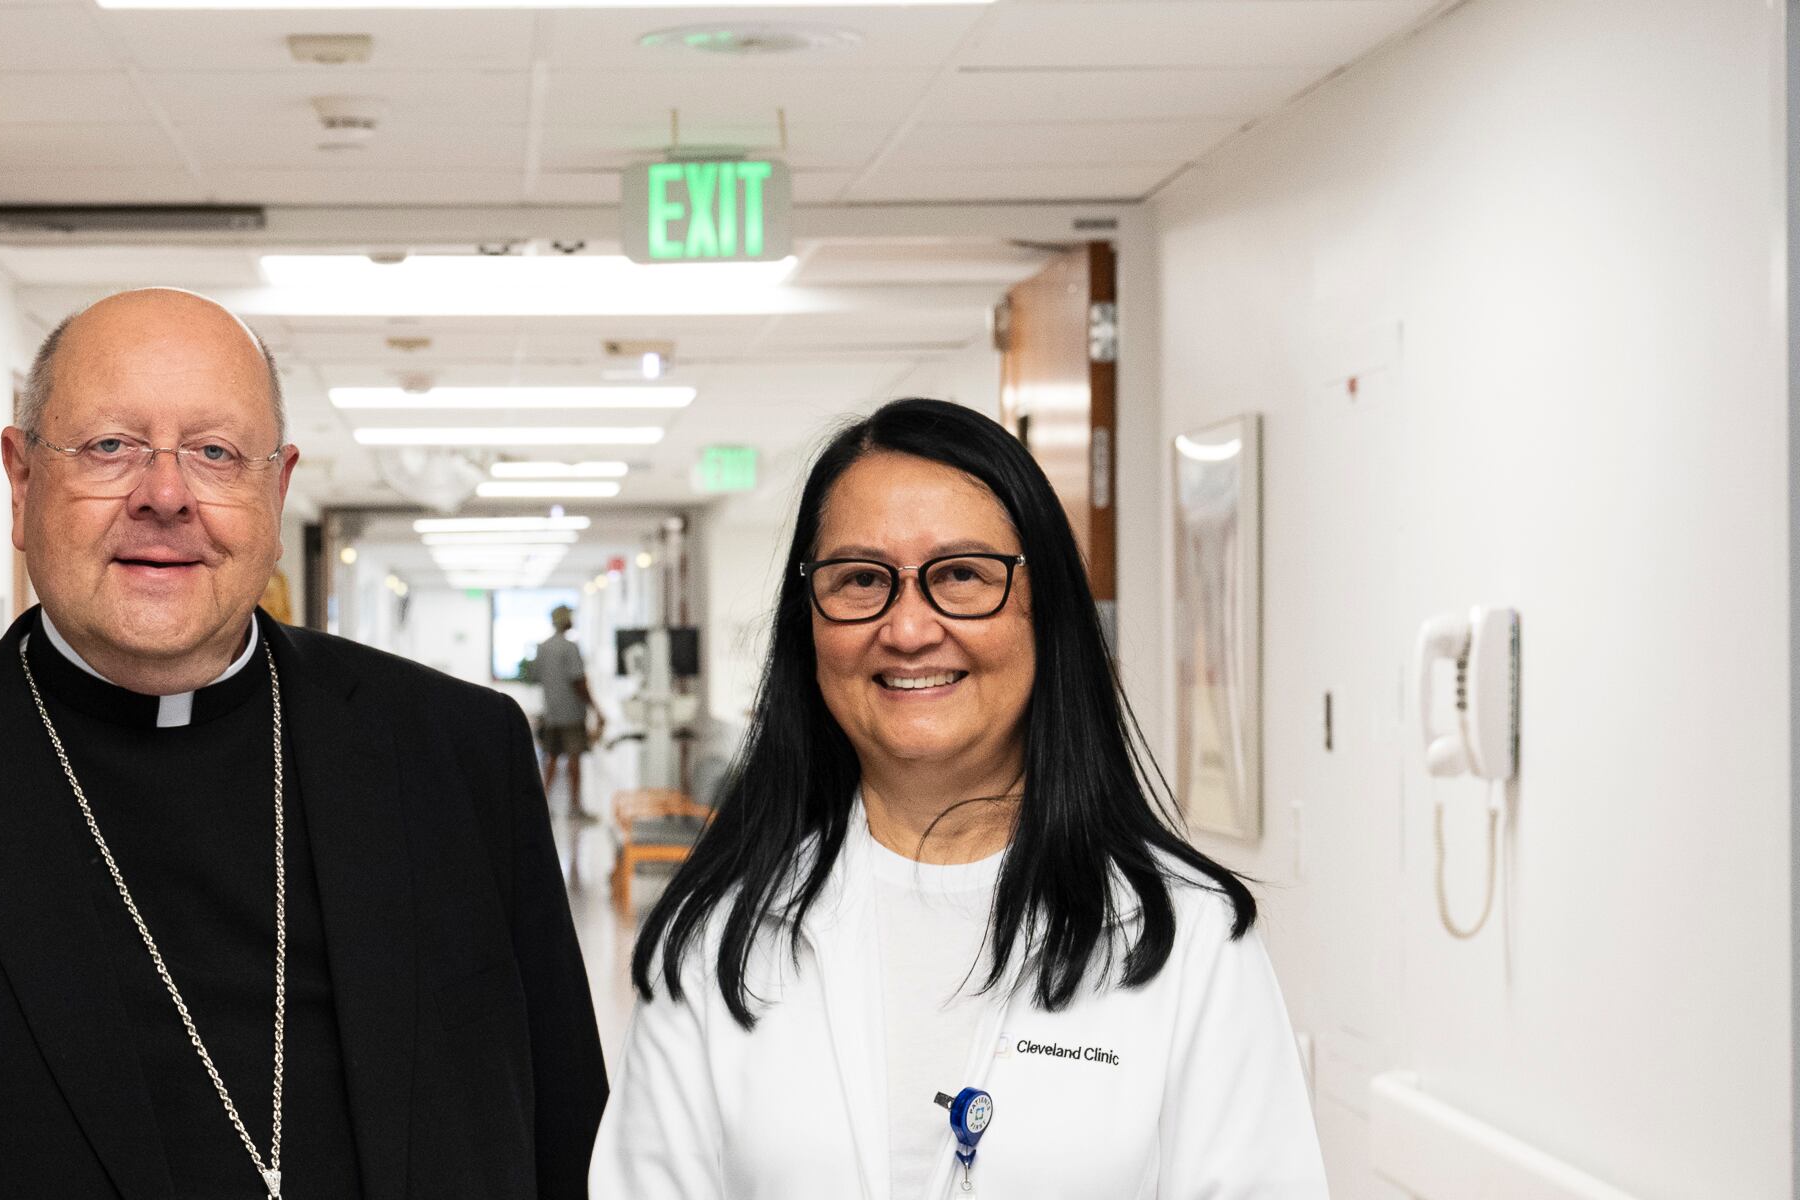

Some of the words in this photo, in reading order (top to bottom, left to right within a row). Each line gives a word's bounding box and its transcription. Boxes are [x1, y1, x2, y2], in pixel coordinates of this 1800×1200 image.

[648, 161, 772, 259] EXIT
[1016, 1039, 1082, 1060] Cleveland
[1083, 1047, 1120, 1066] Clinic
